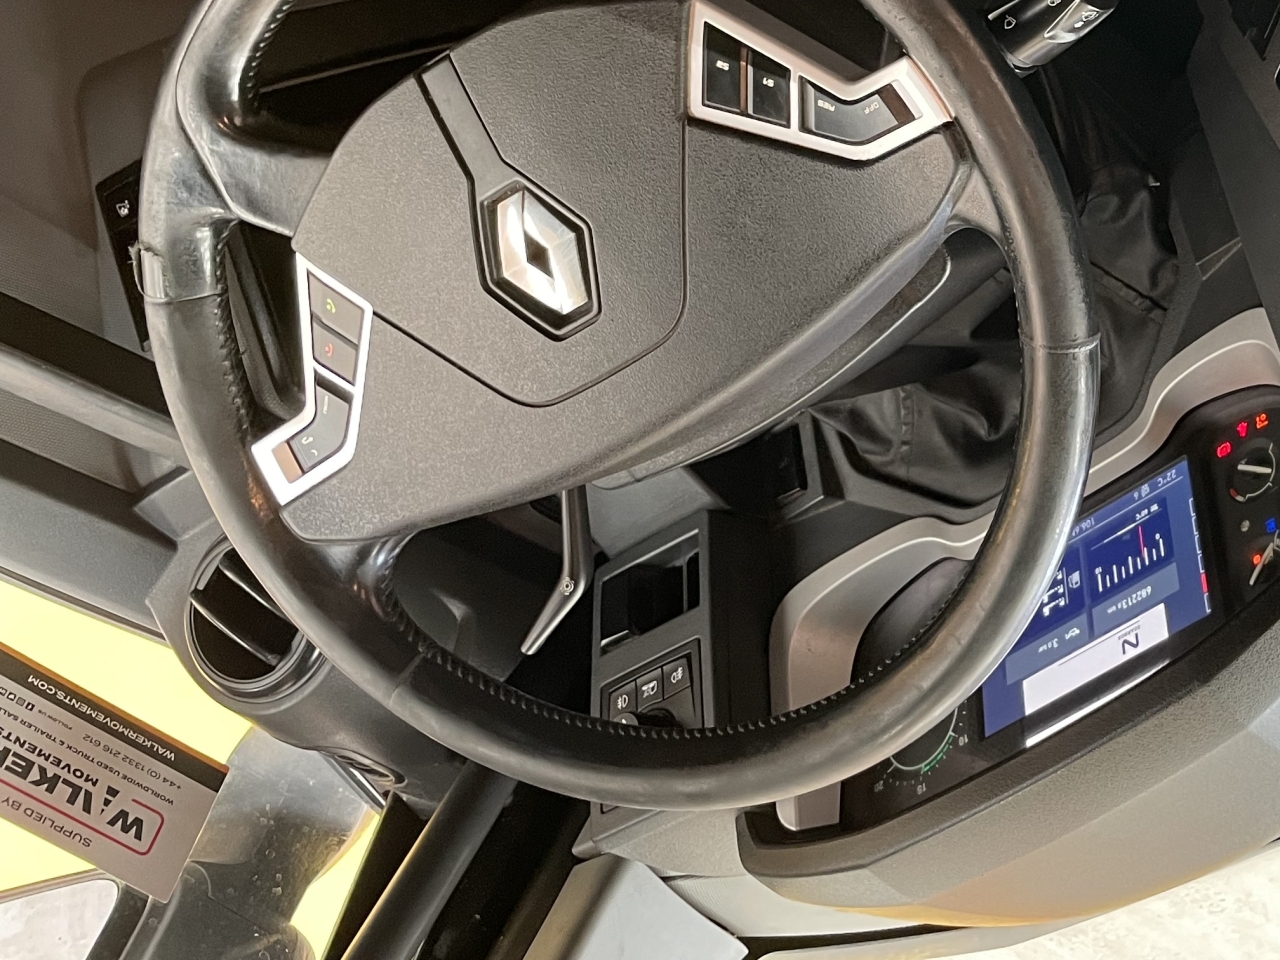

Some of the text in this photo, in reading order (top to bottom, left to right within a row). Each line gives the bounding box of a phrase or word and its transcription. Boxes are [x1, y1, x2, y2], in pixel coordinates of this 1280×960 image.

[716, 60, 729, 71] S2
[762, 77, 775, 88] S1
[817, 99, 836, 112] RES
[864, 101, 880, 115] OFF
[1157, 469, 1178, 488] 22°C
[1122, 633, 1140, 656] N
[27, 674, 176, 762] WALKERMOVEMENTS.COM
[49, 714, 73, 731] FOLLOW
[19, 718, 58, 744] TRAILER
[958, 733, 969, 746] 10
[66, 743, 96, 767] TRUCK
[82, 732, 182, 791] +44 (0) 1332 216 612
[100, 761, 121, 778] USED
[126, 774, 174, 806] WORLDWIDE
[917, 782, 927, 795] 15
[1, 796, 93, 848] SUPPLIED BY
